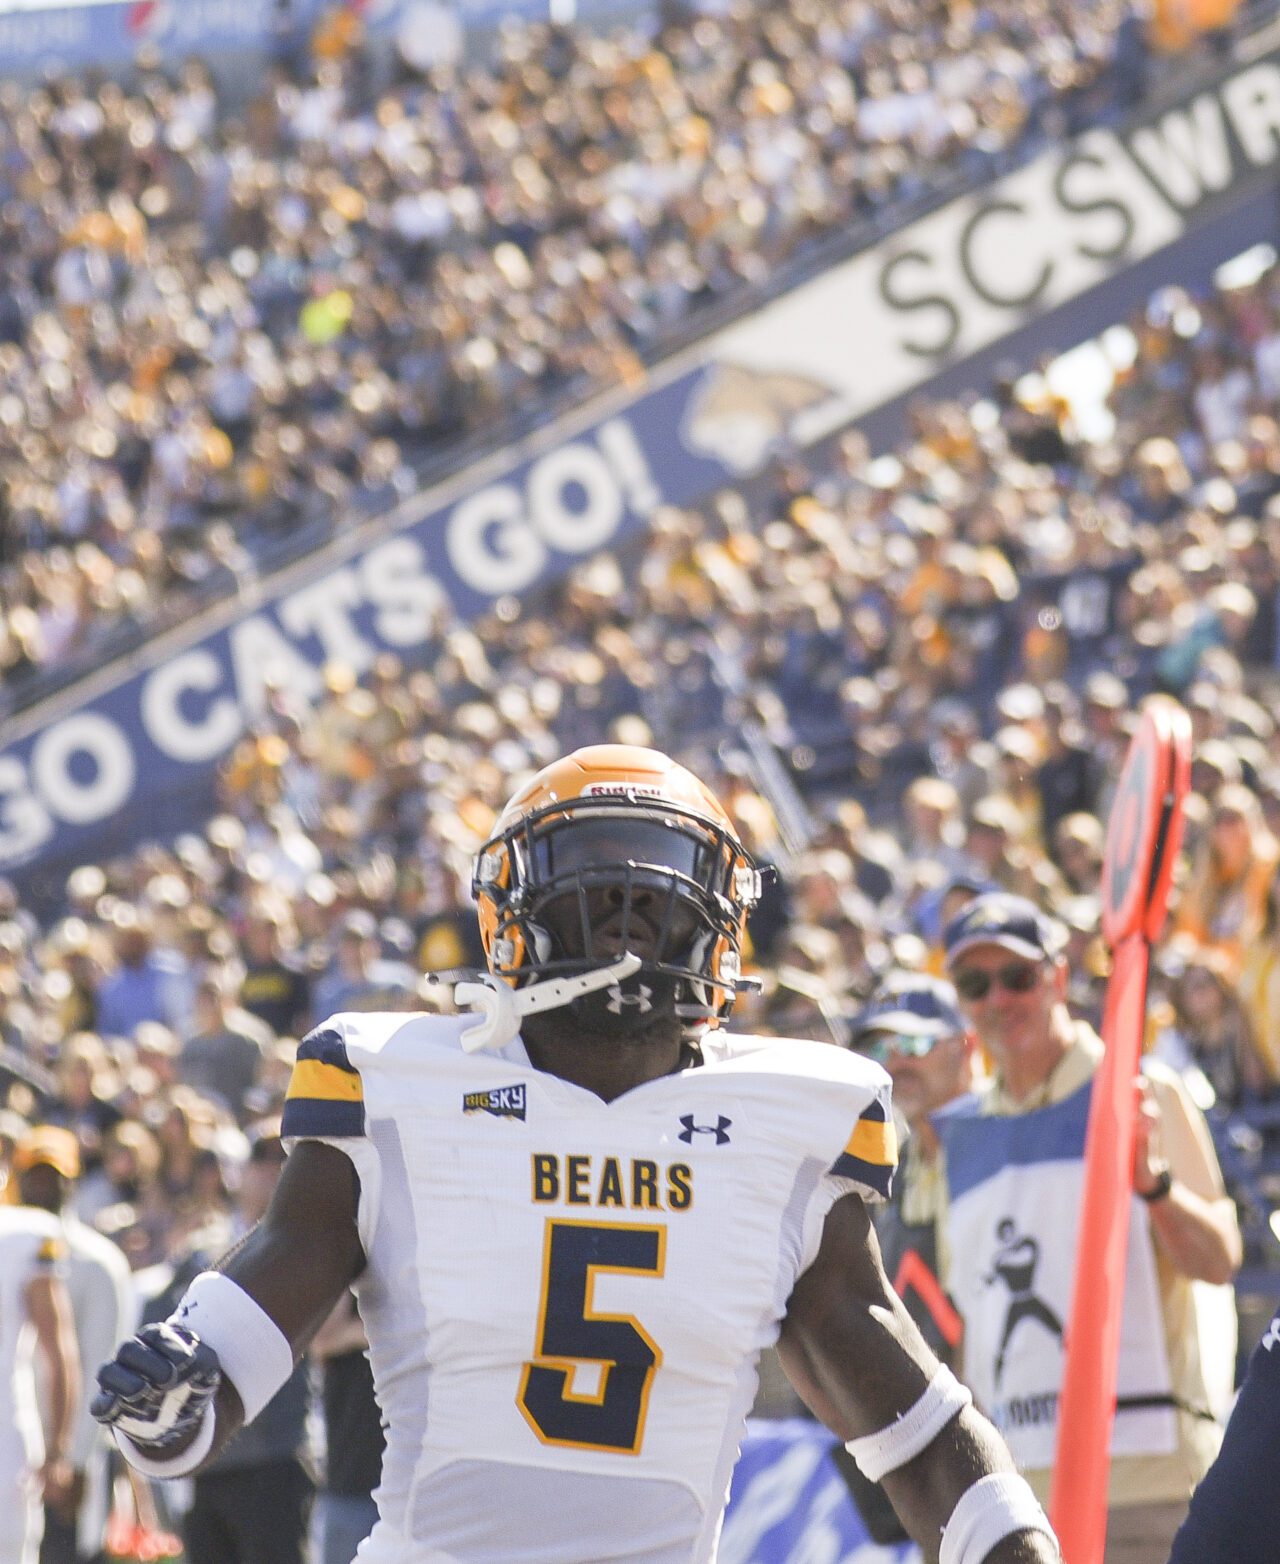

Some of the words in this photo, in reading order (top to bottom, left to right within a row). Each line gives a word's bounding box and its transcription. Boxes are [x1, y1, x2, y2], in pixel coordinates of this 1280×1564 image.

[140, 538, 448, 762] CATS
[445, 418, 661, 593] GO!
[531, 1152, 694, 1213] BEARS
[515, 1217, 667, 1457] 5
